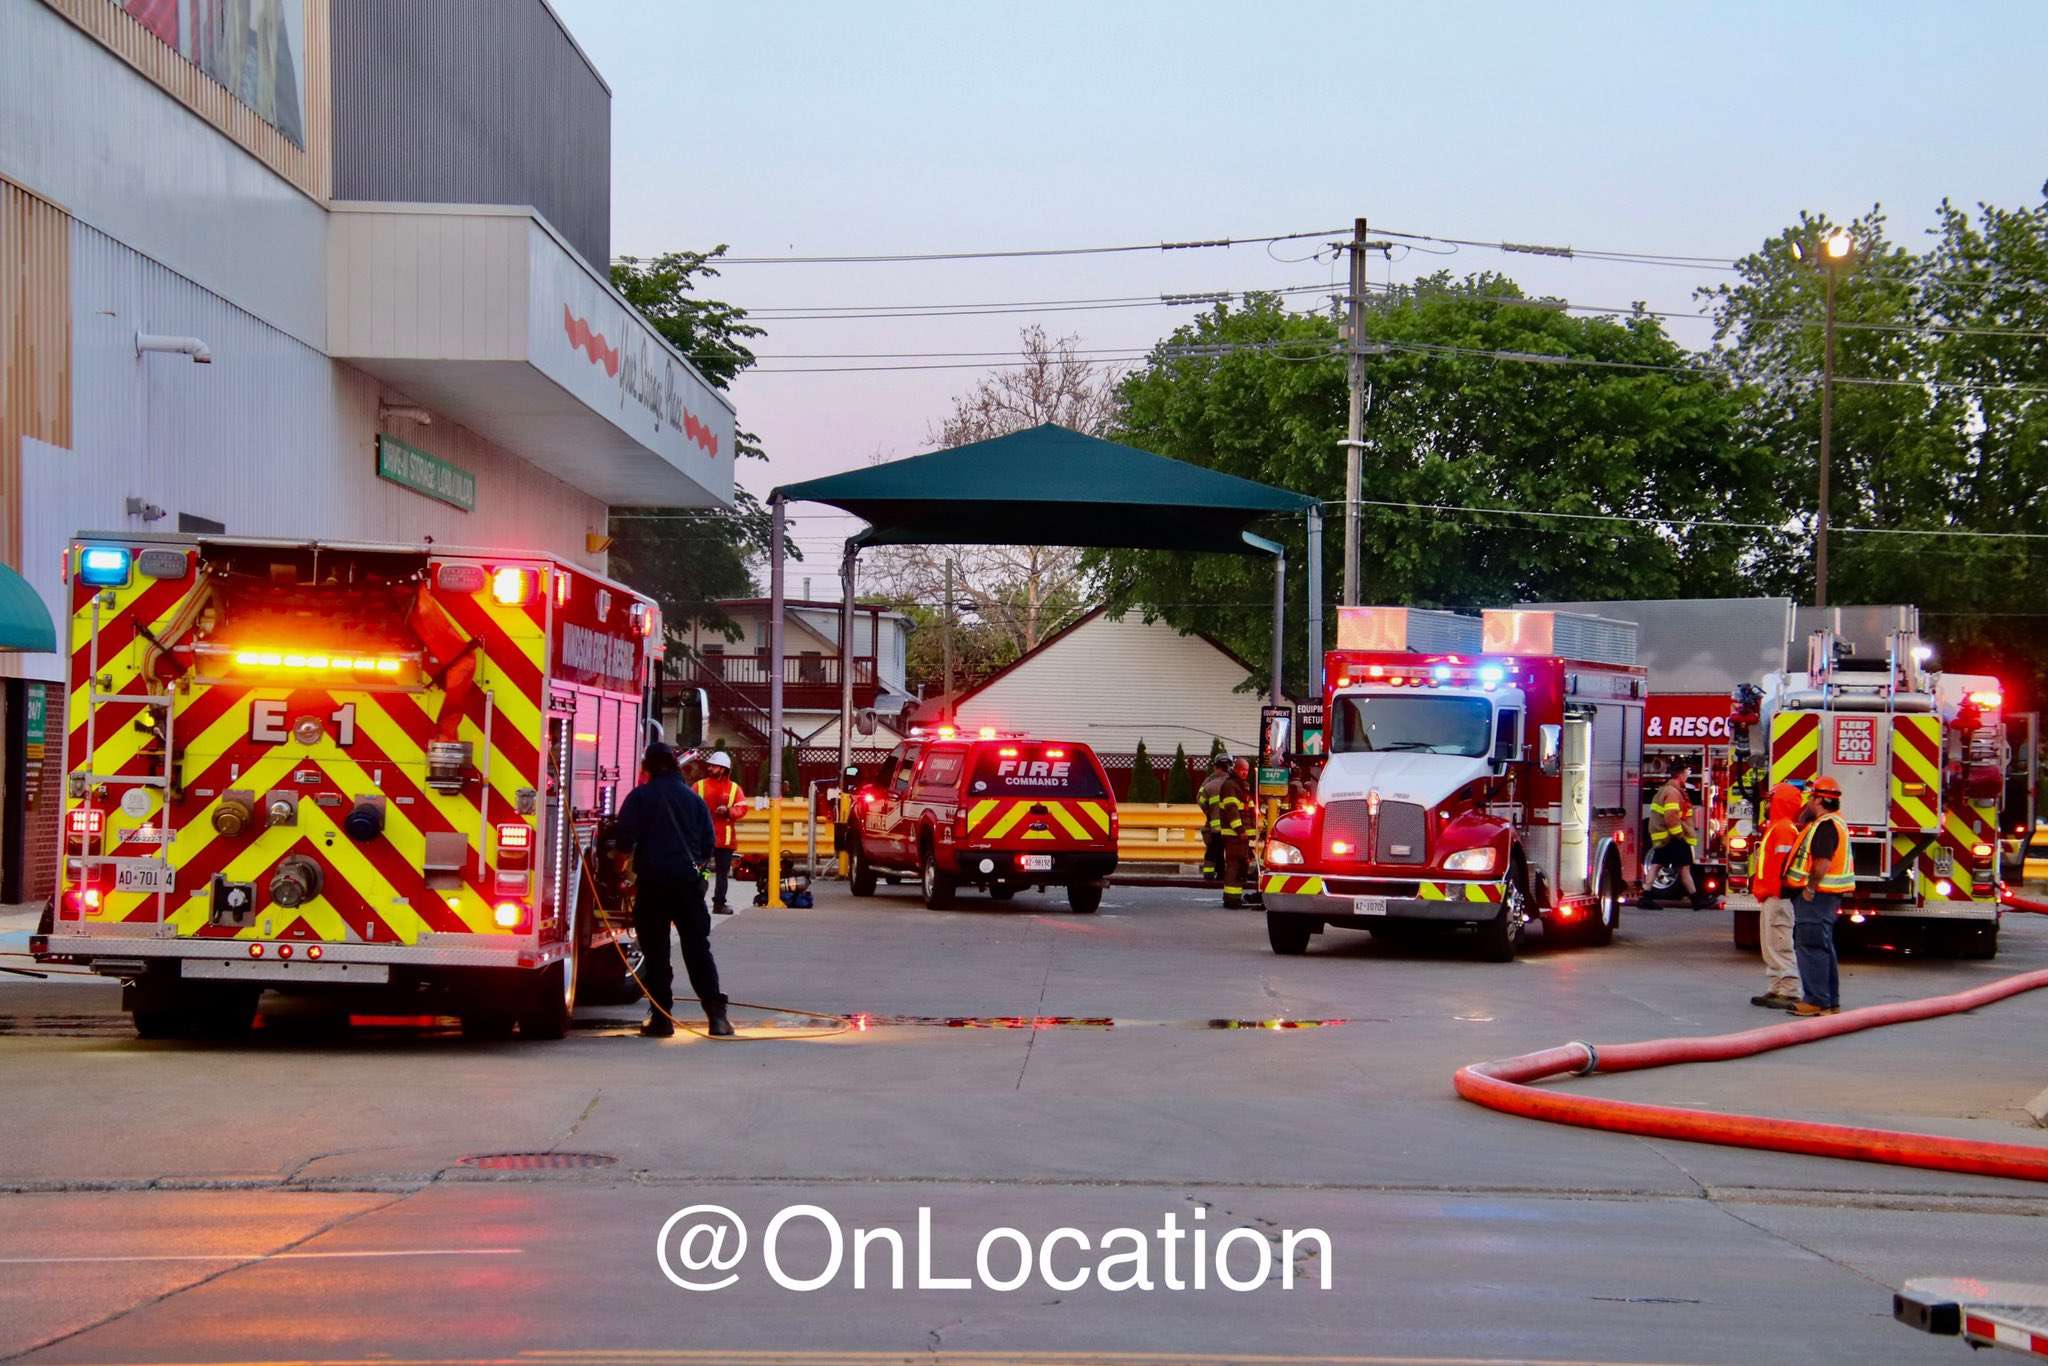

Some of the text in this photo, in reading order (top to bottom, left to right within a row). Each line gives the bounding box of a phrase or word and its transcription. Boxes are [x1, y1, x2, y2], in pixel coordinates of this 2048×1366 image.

[1297, 704, 1323, 713] EQUIPM
[252, 700, 356, 745] E 1
[1303, 716, 1323, 724] RETU
[1647, 716, 1730, 737] & RESC
[1840, 721, 1871, 729] KEEP
[1840, 730, 1870, 739] BACK
[1839, 739, 1872, 750] 500
[1838, 751, 1872, 760] FEET
[998, 761, 1071, 777] FIRE
[1005, 777, 1069, 786] COMMAND 2
